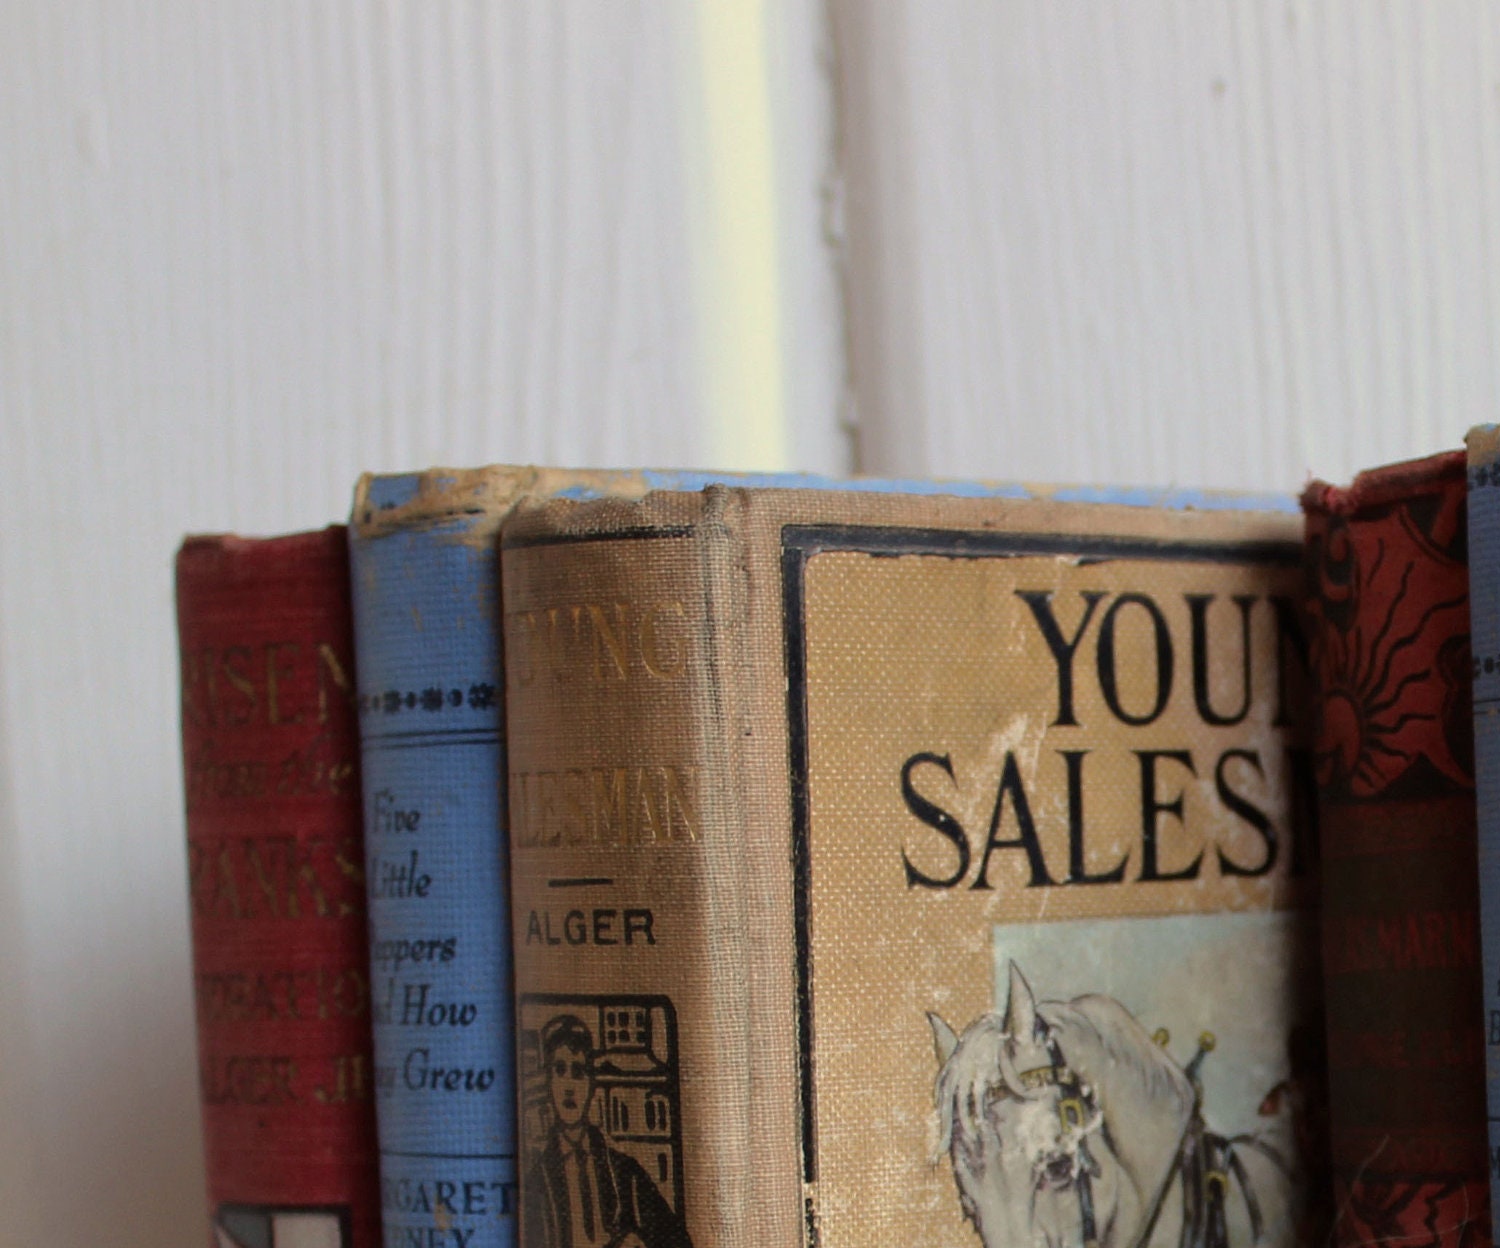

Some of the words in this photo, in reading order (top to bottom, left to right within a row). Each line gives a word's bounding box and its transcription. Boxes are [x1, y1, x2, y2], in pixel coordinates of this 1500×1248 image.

[525, 908, 656, 946] ALGER
[402, 983, 477, 1027] How
[404, 1048, 495, 1093] Grew
